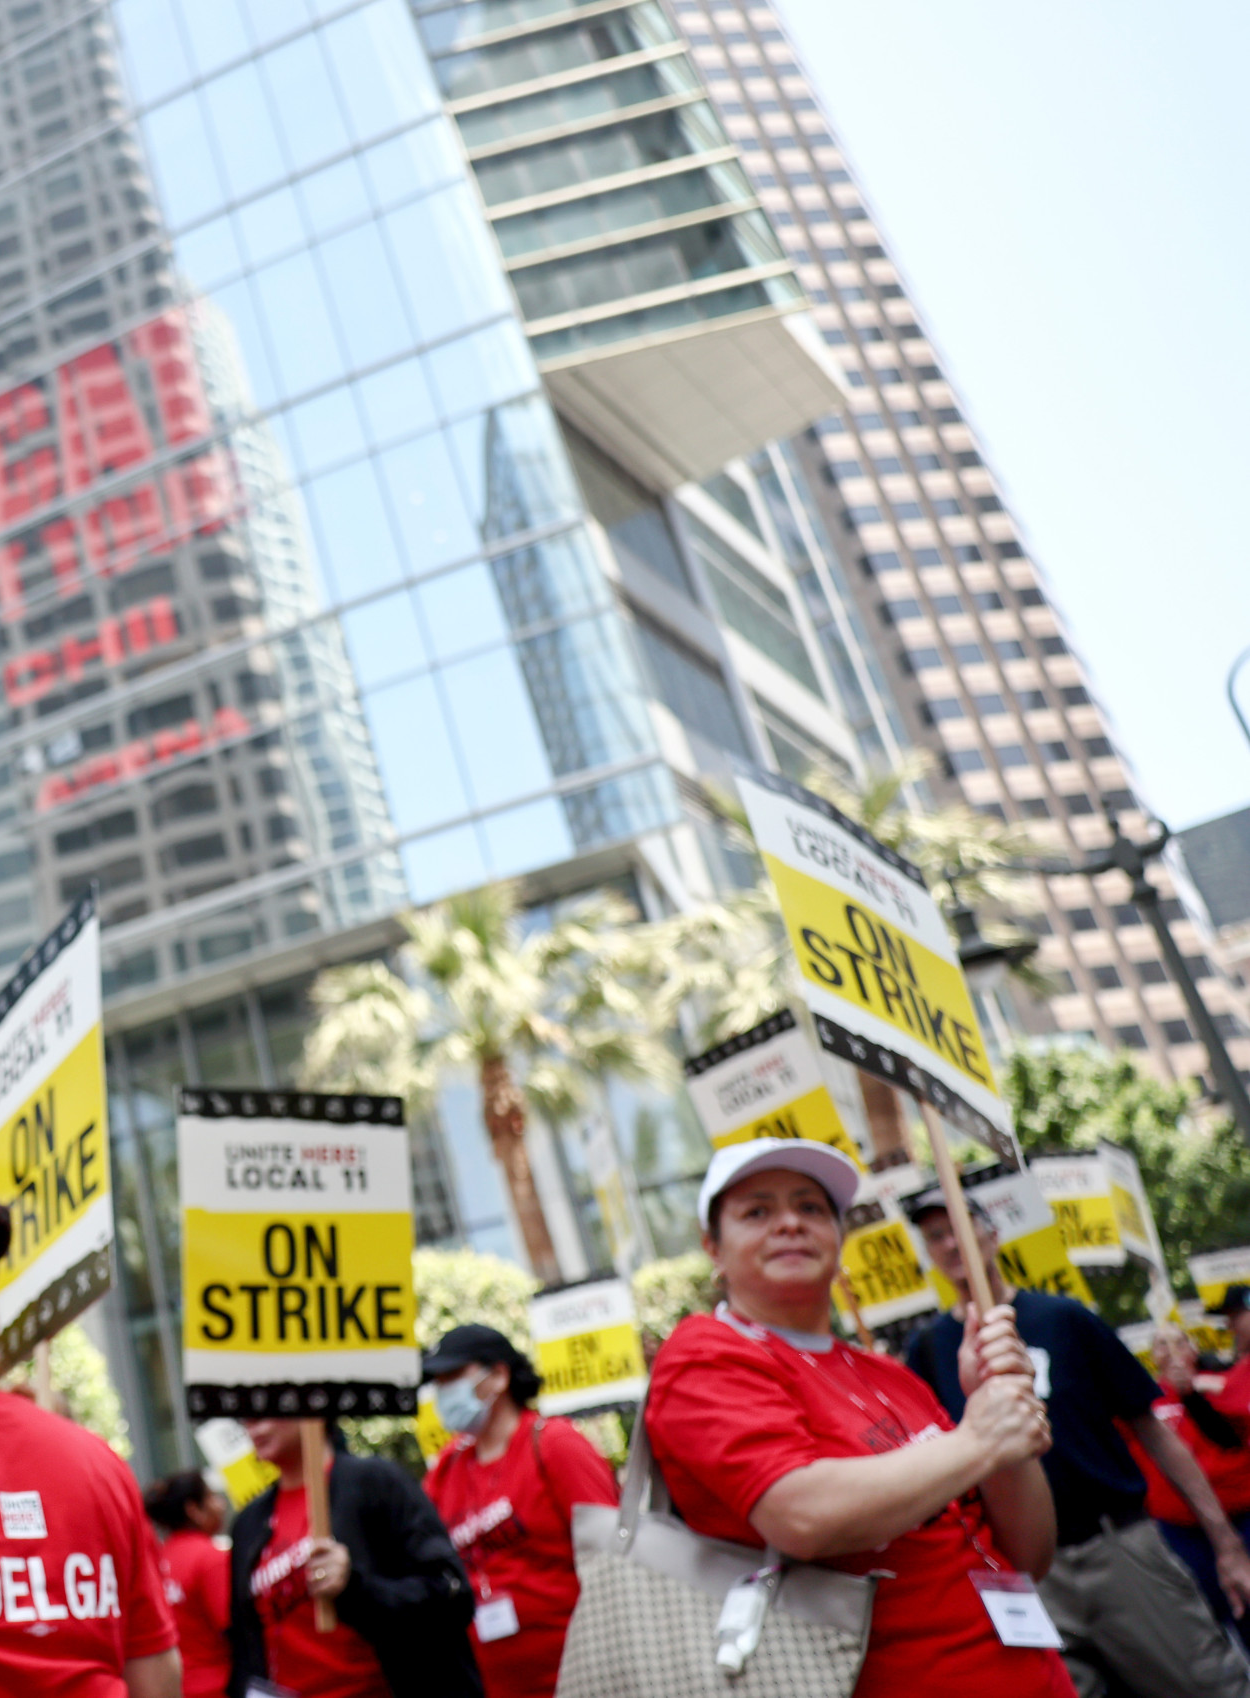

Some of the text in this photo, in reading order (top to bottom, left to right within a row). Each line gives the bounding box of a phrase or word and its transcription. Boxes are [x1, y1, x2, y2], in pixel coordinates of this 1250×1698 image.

[792, 835, 884, 904] LOCAL
[846, 904, 919, 988] ON
[802, 928, 988, 1085] STRIKE
[11, 1086, 56, 1185] ON
[224, 1143, 366, 1167] UNITE HERE!
[225, 1166, 368, 1192] LOCAL 11
[263, 1223, 339, 1281] ON
[859, 1232, 906, 1266] ON
[200, 1283, 406, 1342] STRIKE
